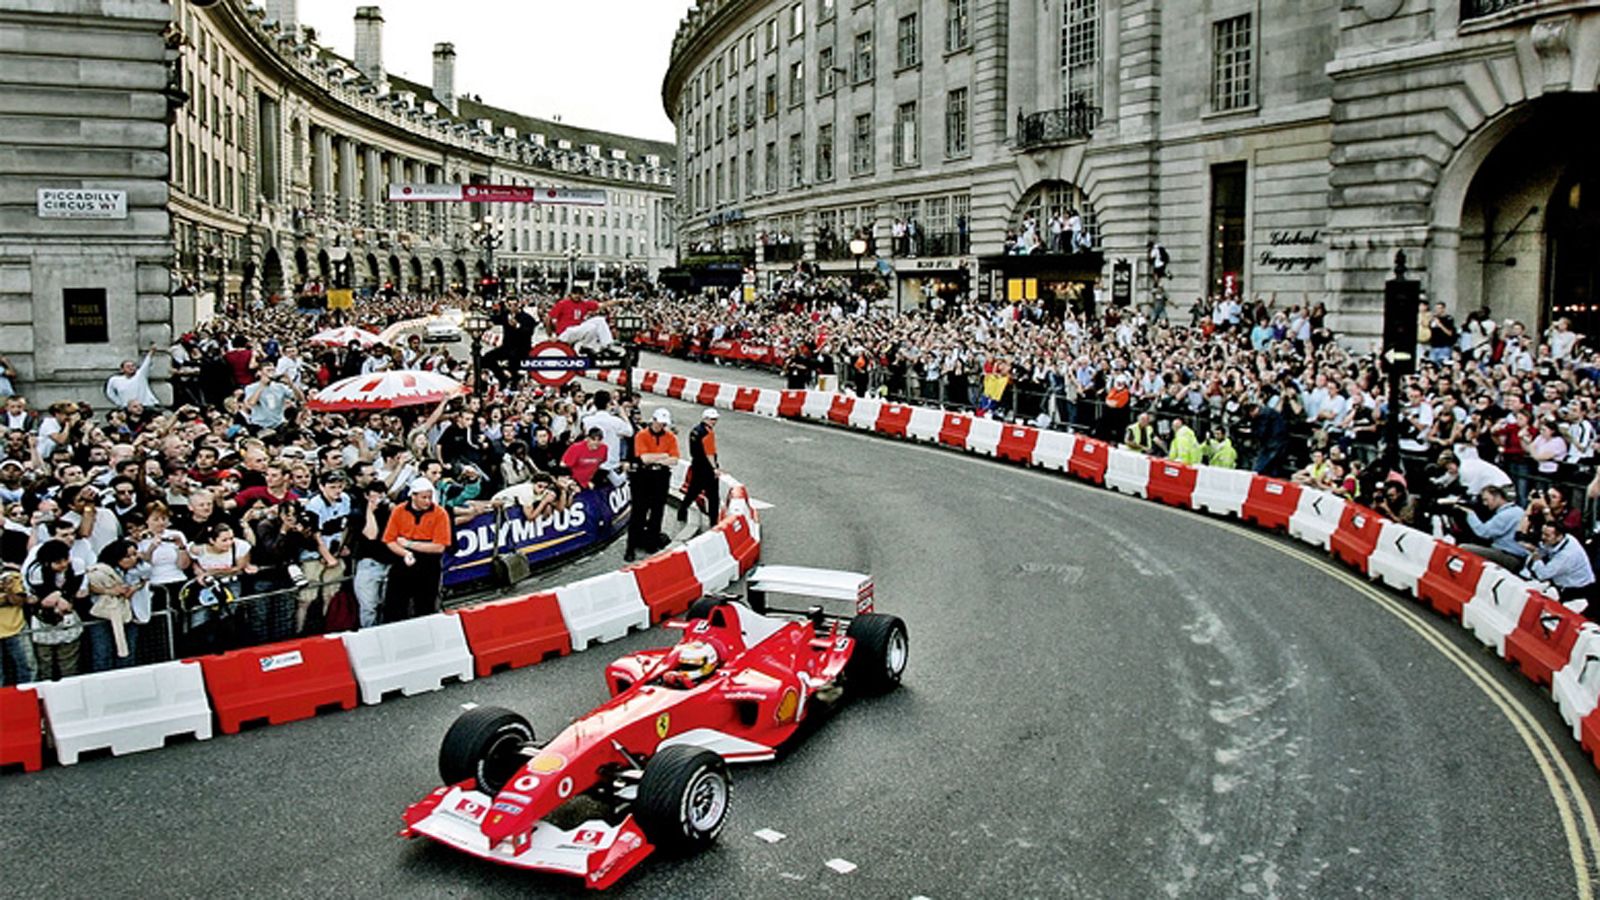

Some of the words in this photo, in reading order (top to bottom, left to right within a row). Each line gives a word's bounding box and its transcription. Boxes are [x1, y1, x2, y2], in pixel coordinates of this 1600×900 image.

[43, 191, 120, 201] PICCADILLY
[44, 201, 95, 211] CIRCUS
[100, 203, 117, 211] W1
[1270, 230, 1322, 246] Global
[1260, 249, 1325, 272] Luggage
[520, 359, 586, 368] UNDERGROUND
[453, 502, 587, 558] OLYMPUS
